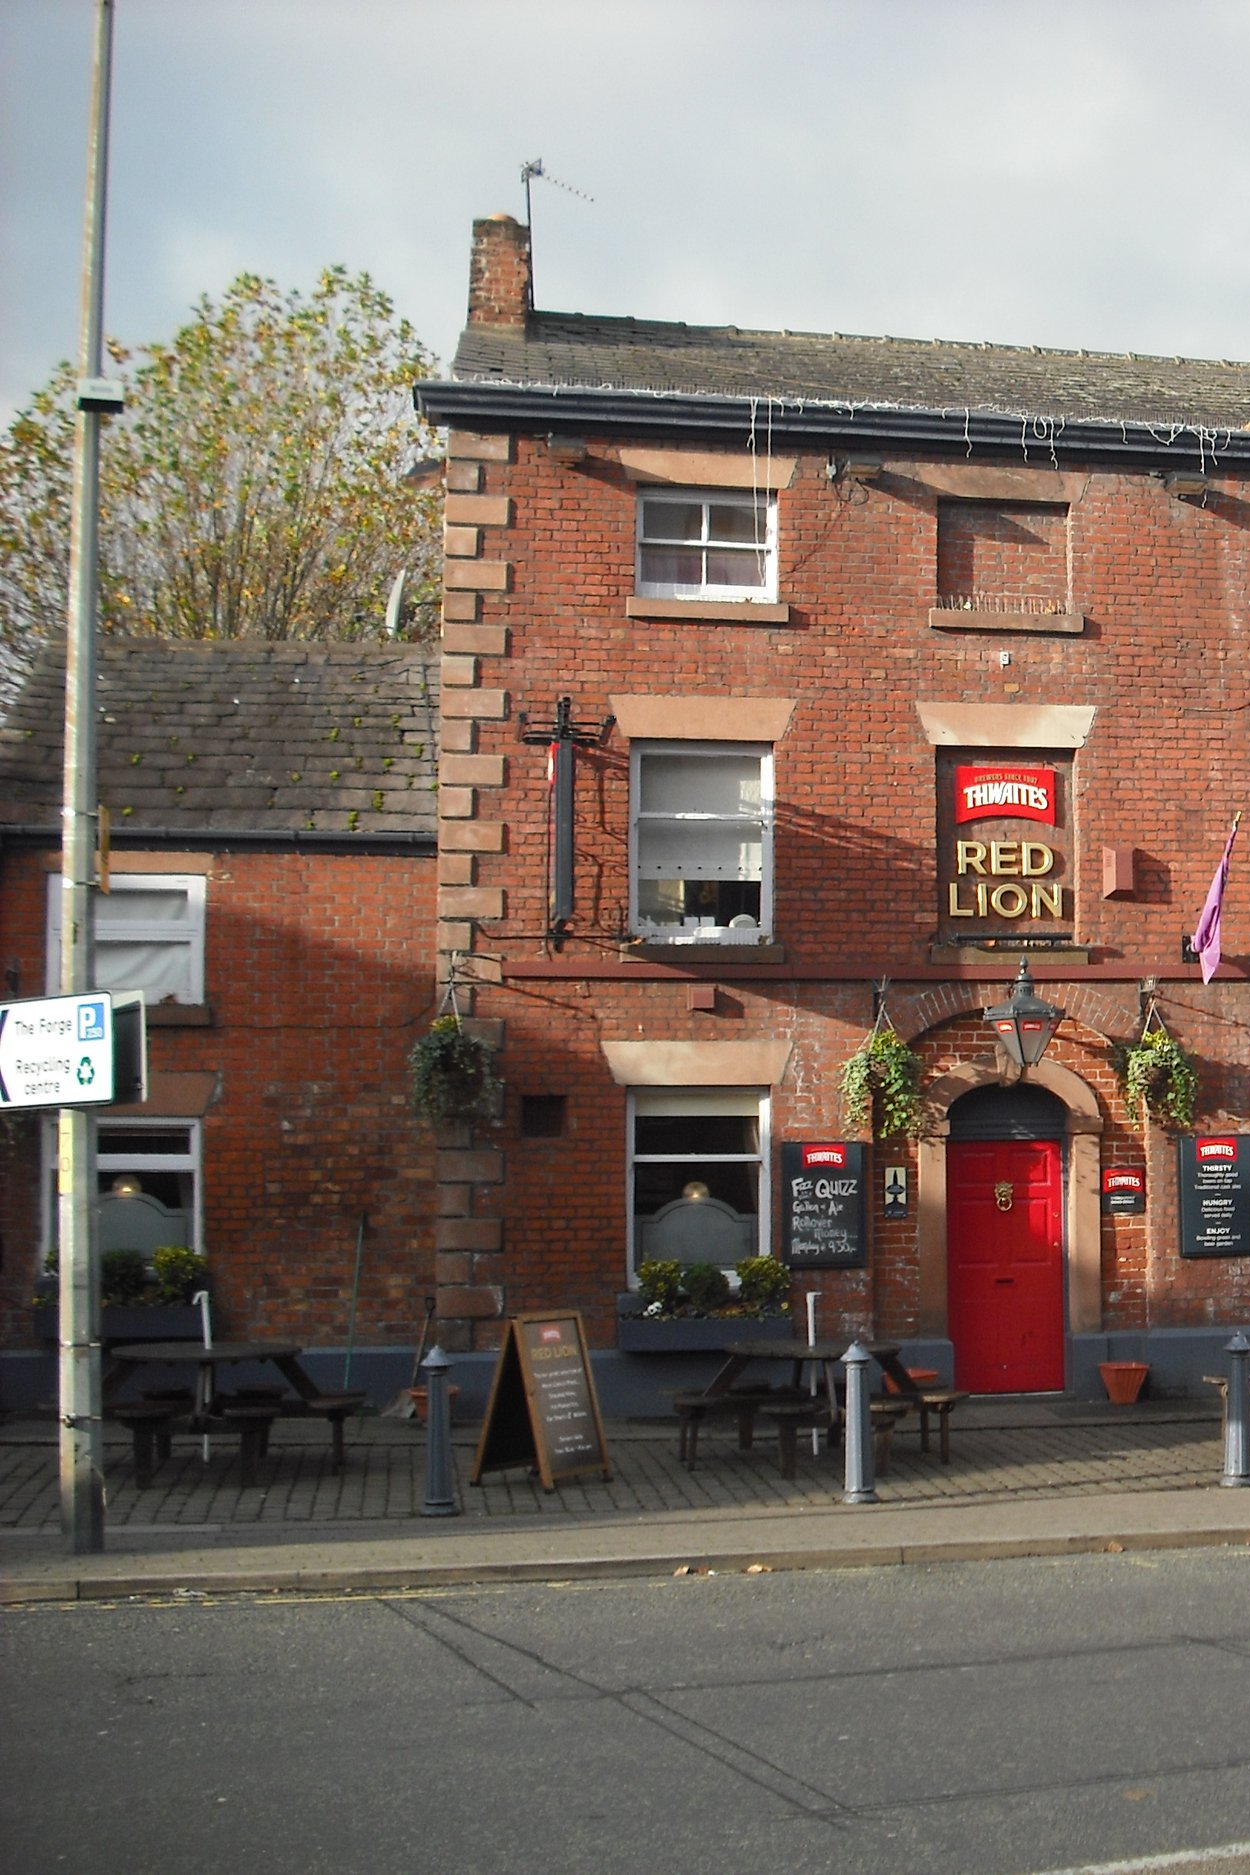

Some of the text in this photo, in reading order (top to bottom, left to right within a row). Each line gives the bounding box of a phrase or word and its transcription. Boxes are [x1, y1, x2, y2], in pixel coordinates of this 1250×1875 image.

[963, 781, 1048, 810] THWAITES
[957, 840, 1054, 877] RED
[949, 883, 1063, 919] LION
[15, 1007, 97, 1039] The Forge P
[16, 1056, 70, 1076] Recycling
[25, 1082, 60, 1095] centre
[1200, 1145, 1234, 1158] THWAITES
